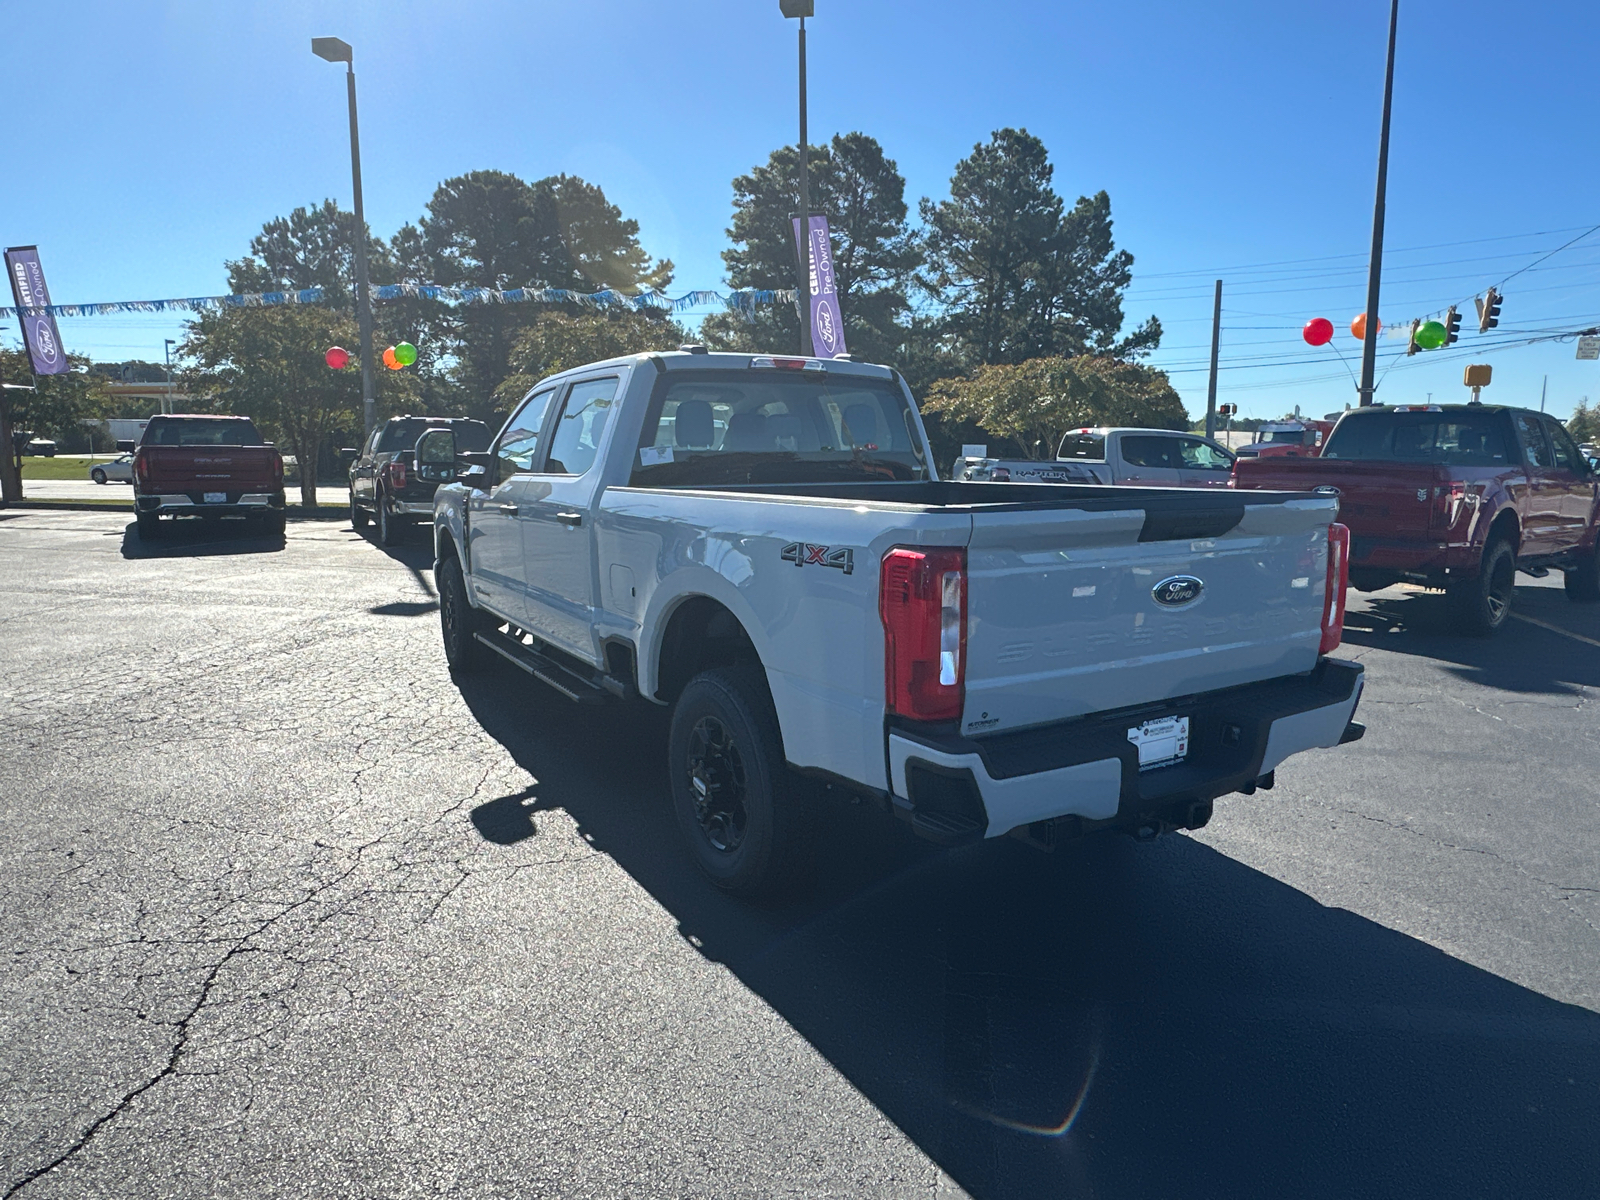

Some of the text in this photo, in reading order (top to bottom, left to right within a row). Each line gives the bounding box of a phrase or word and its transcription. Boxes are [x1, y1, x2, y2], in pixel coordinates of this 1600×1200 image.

[809, 233, 819, 296] CERTI
[814, 229, 833, 295] Pre-Owned
[15, 263, 35, 316] RTIFIED
[27, 262, 47, 315] Pe-Owned
[39, 329, 55, 355] Ford
[819, 312, 833, 343] Ford
[1015, 470, 1068, 481] RAPTOR
[997, 621, 1189, 664] SUPER
